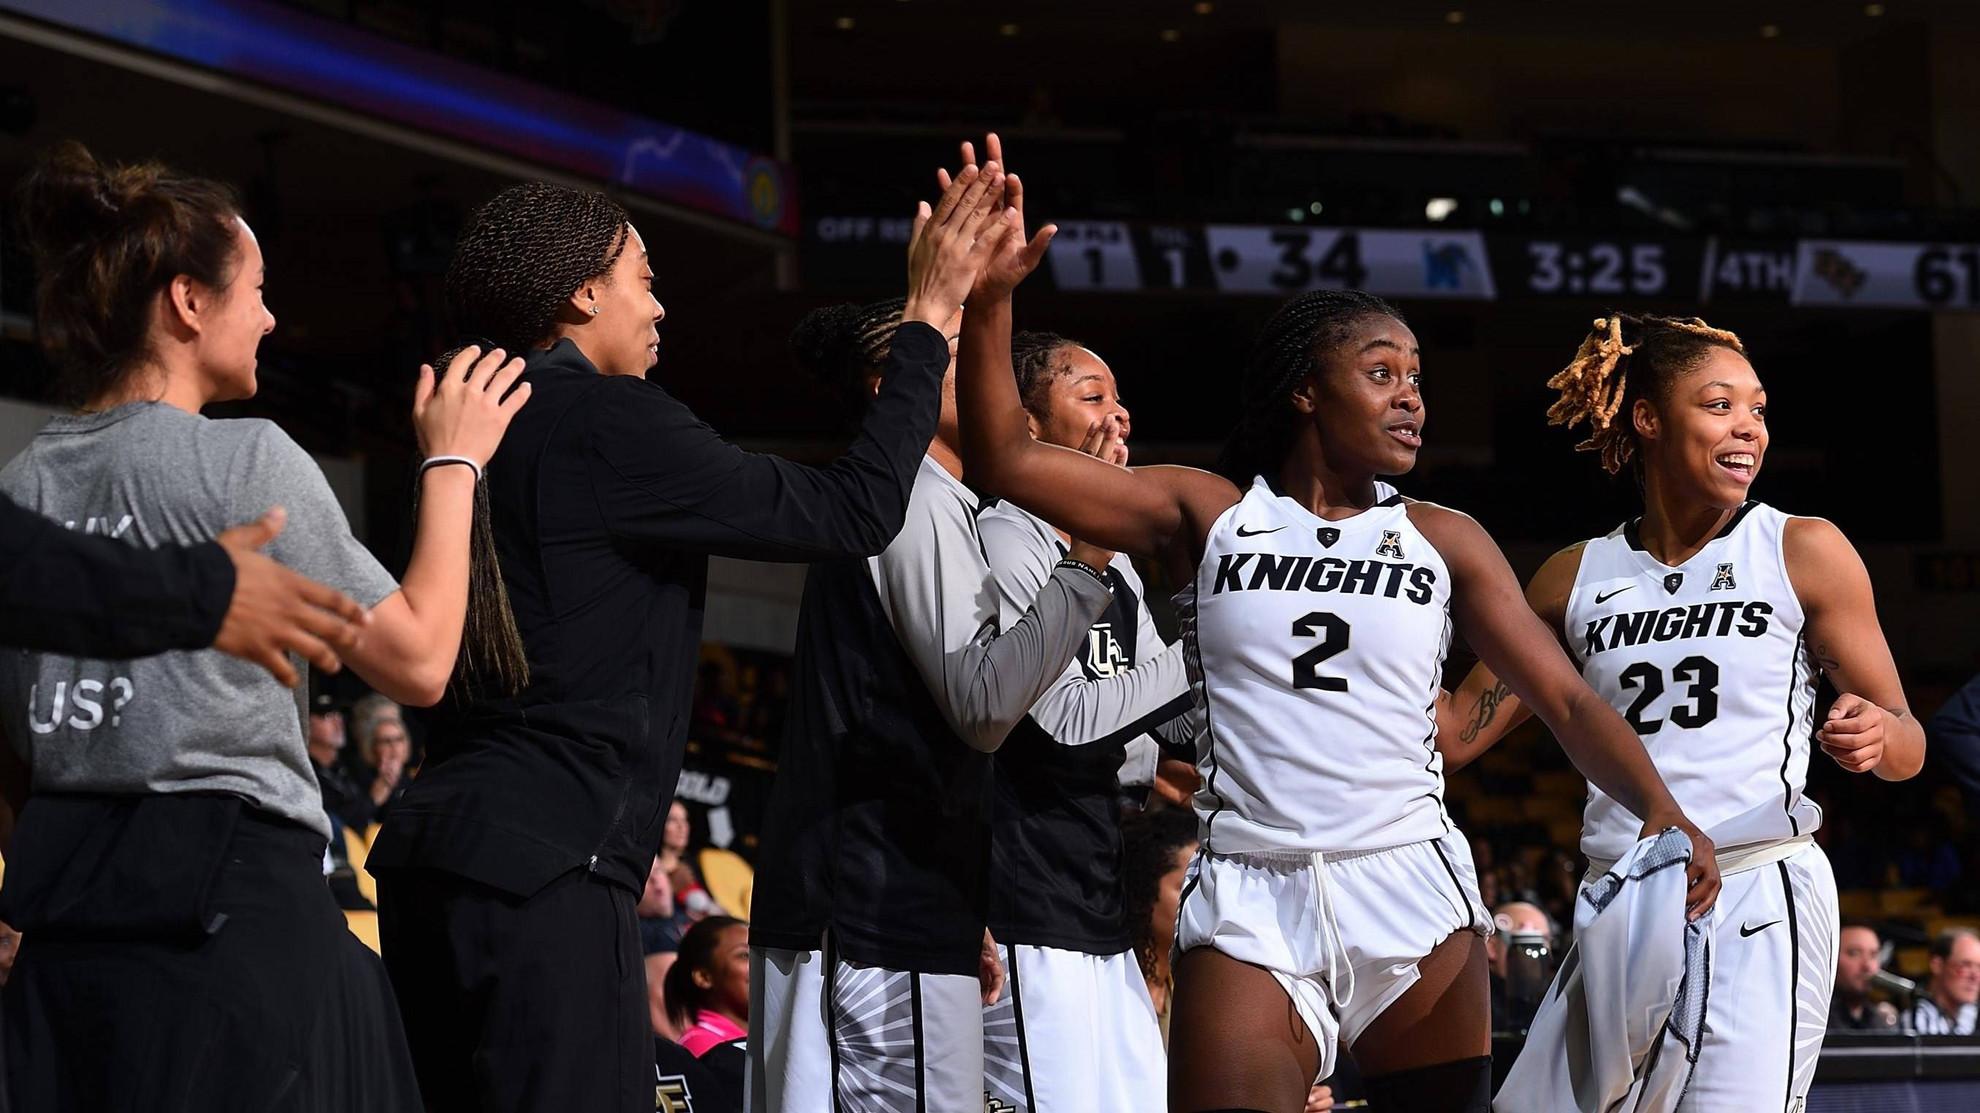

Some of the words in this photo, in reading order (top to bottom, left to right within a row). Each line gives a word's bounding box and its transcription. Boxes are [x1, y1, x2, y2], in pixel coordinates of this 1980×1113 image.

[1085, 249, 1104, 284] 1
[1162, 250, 1187, 290] 1
[1270, 231, 1367, 288] 34
[1526, 241, 1667, 293] 3:25
[1717, 251, 1794, 292] 4TH
[1212, 552, 1437, 606] KNIGHTS
[1291, 611, 1351, 692] 2
[1585, 601, 1774, 657] KNIGHTS
[28, 676, 134, 734] US?
[1619, 655, 1720, 735] 23
